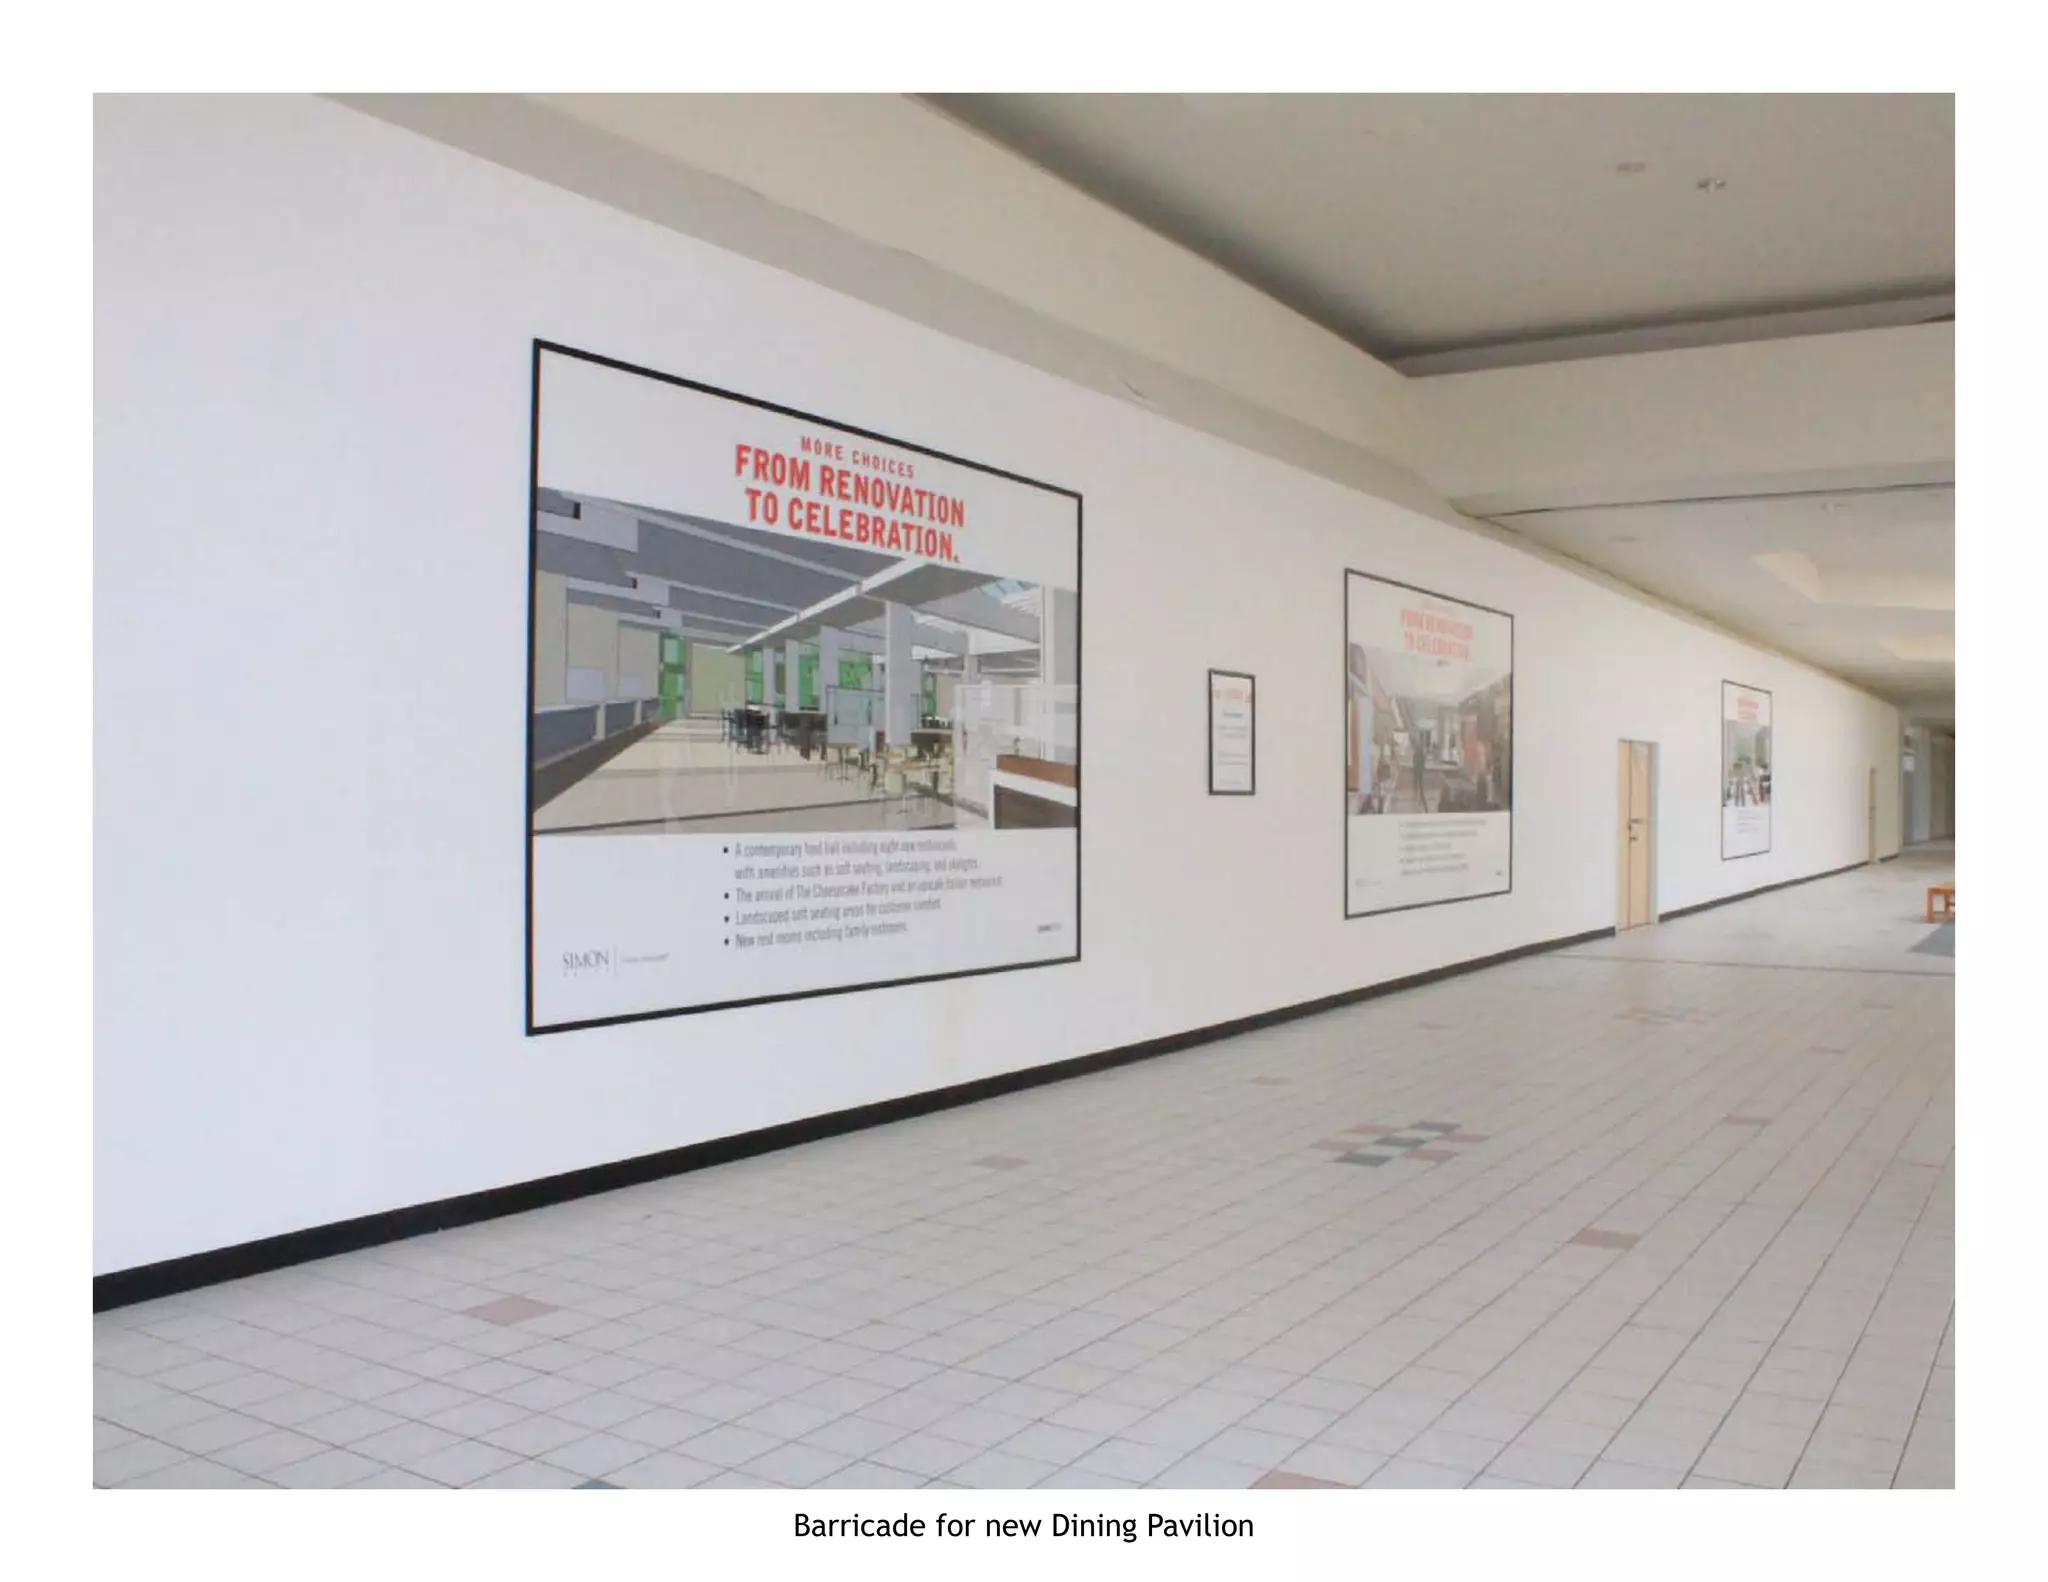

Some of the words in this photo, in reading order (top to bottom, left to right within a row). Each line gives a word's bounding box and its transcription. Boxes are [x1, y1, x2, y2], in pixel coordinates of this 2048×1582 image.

[801, 435, 844, 460] MORE
[851, 449, 914, 479] CHOICES
[735, 443, 810, 492] FROM
[819, 464, 965, 528] RENOVATION
[745, 487, 778, 526] TO
[787, 496, 960, 563] CELEBRATION.
[744, 843, 802, 858] contemporary
[734, 864, 755, 879] with
[736, 886, 753, 902] The
[785, 884, 794, 901] of
[797, 884, 811, 899] The
[735, 909, 789, 925] Landscaped
[735, 932, 755, 949] New
[562, 949, 610, 970] SIMON
